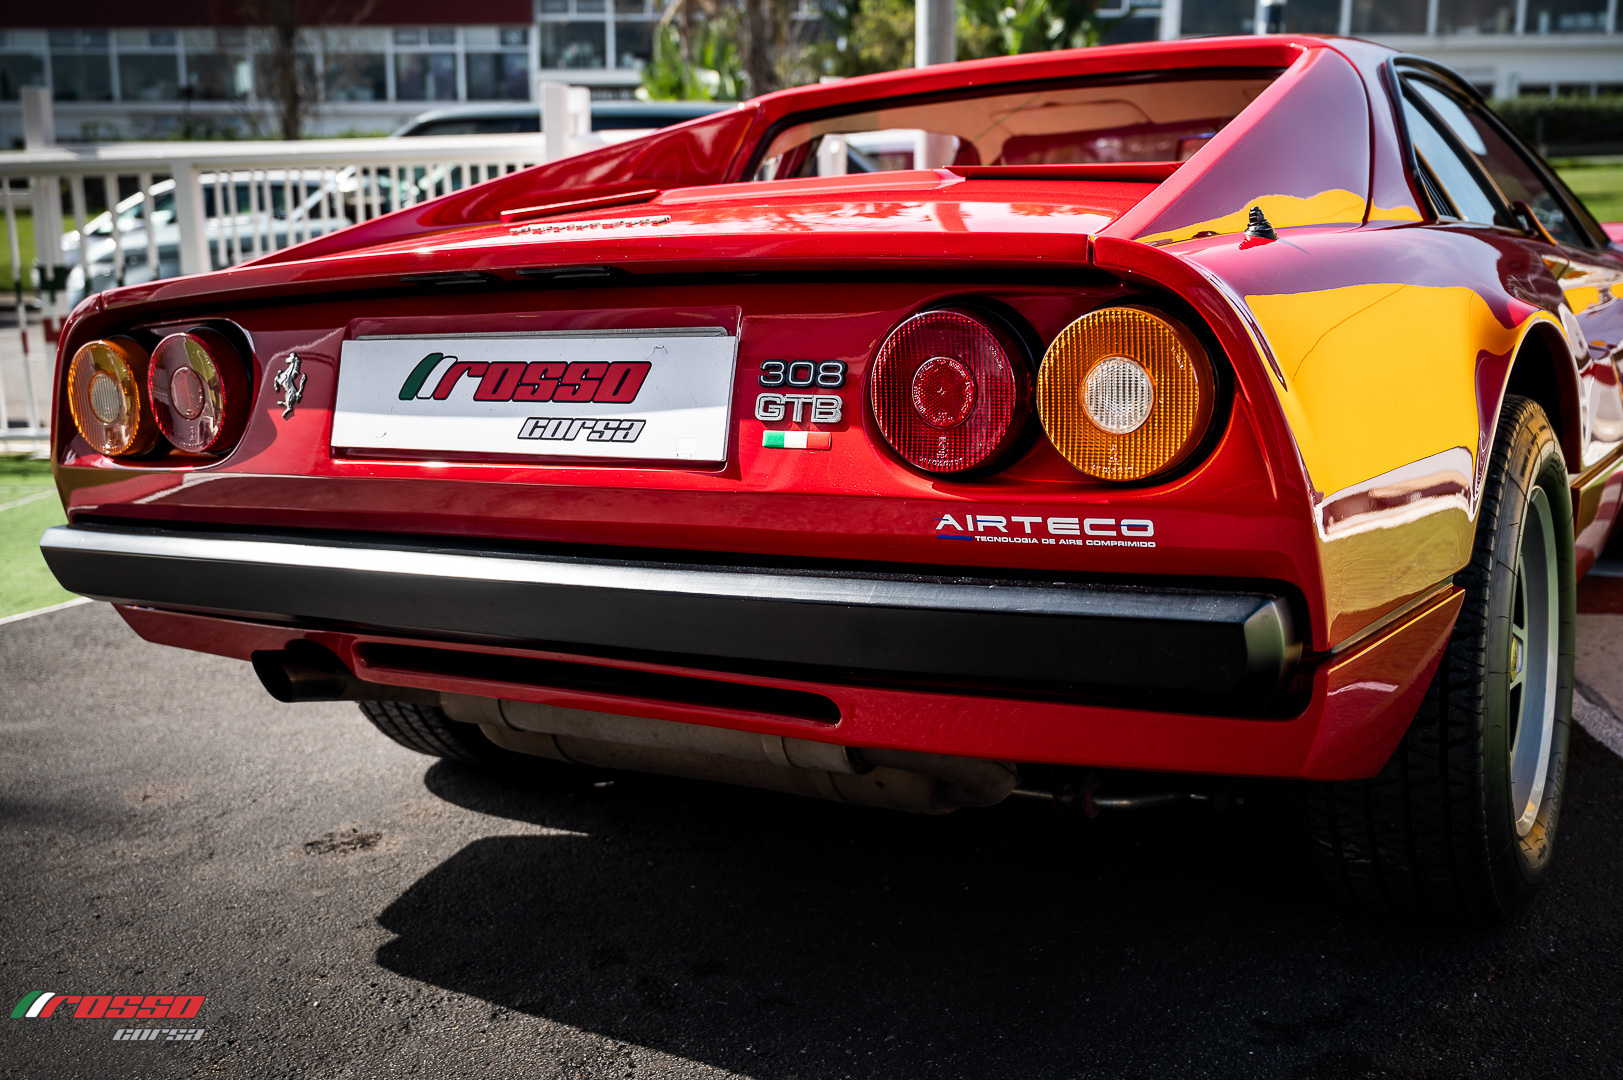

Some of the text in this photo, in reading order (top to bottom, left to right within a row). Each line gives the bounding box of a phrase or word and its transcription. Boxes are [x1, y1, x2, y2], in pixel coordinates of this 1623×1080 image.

[758, 359, 847, 388] 308
[755, 392, 842, 423] GTB
[517, 416, 646, 443] corsa
[934, 513, 1155, 538] AIRTECO
[975, 535, 1157, 548] TECNOLOGIA DE AIRE COMPRIMIDO
